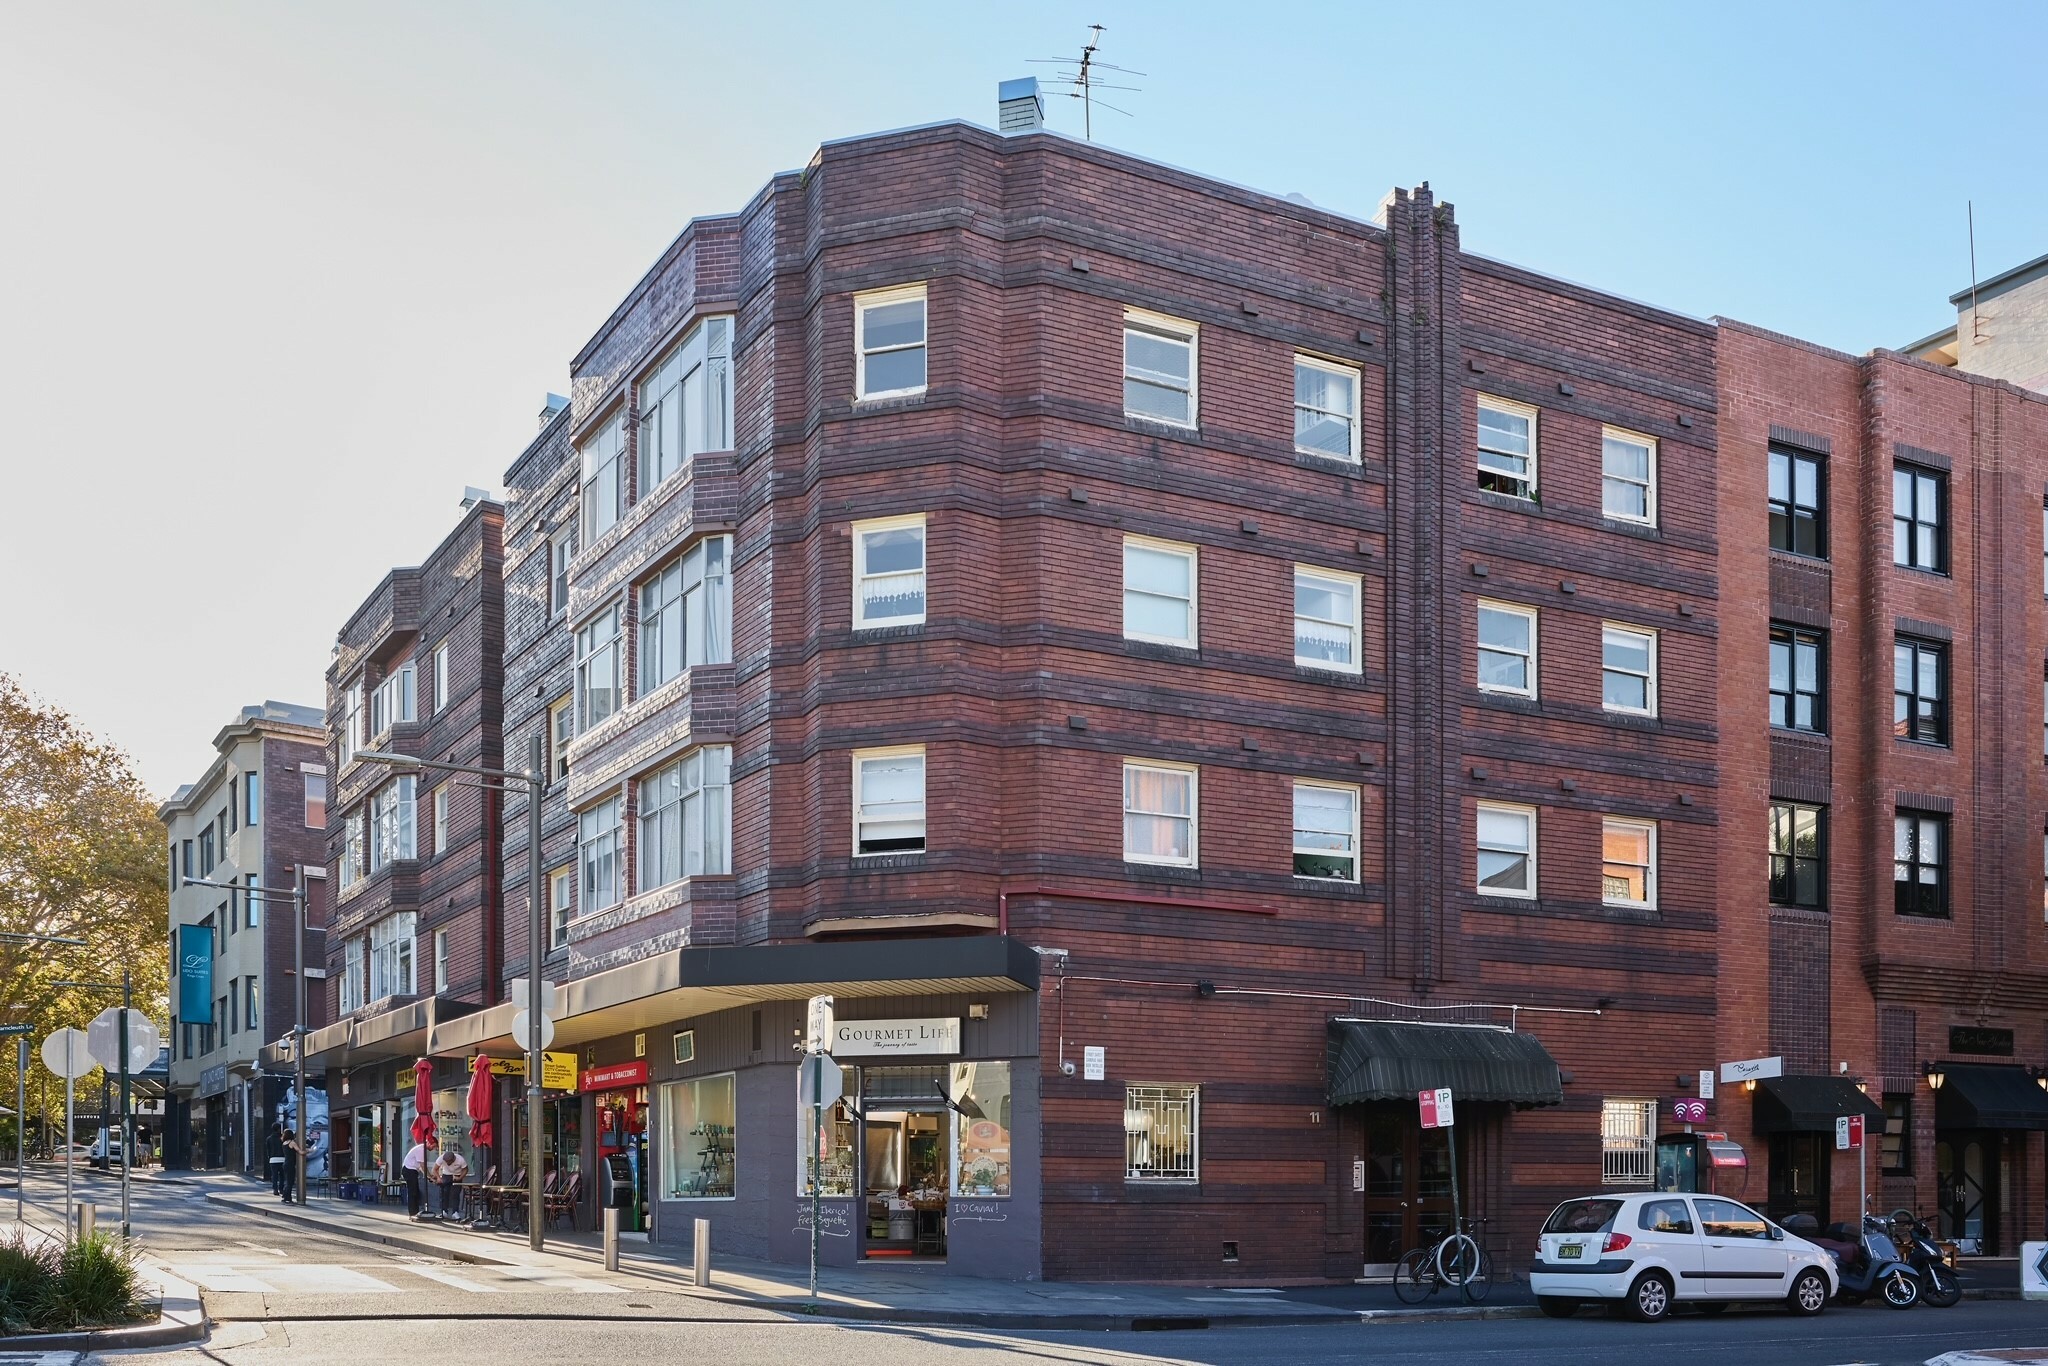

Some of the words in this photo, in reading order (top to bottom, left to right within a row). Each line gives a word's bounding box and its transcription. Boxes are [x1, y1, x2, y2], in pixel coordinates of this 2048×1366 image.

[810, 1001, 822, 1016] ONE
[810, 1019, 822, 1031] WAY
[838, 1027, 914, 1041] GOURMET
[919, 1025, 956, 1039] LIFE
[614, 1068, 637, 1079] TOBACCONIST
[1438, 1092, 1450, 1103] 1P
[1309, 1111, 1320, 1124] 11
[1837, 1120, 1847, 1129] 1P
